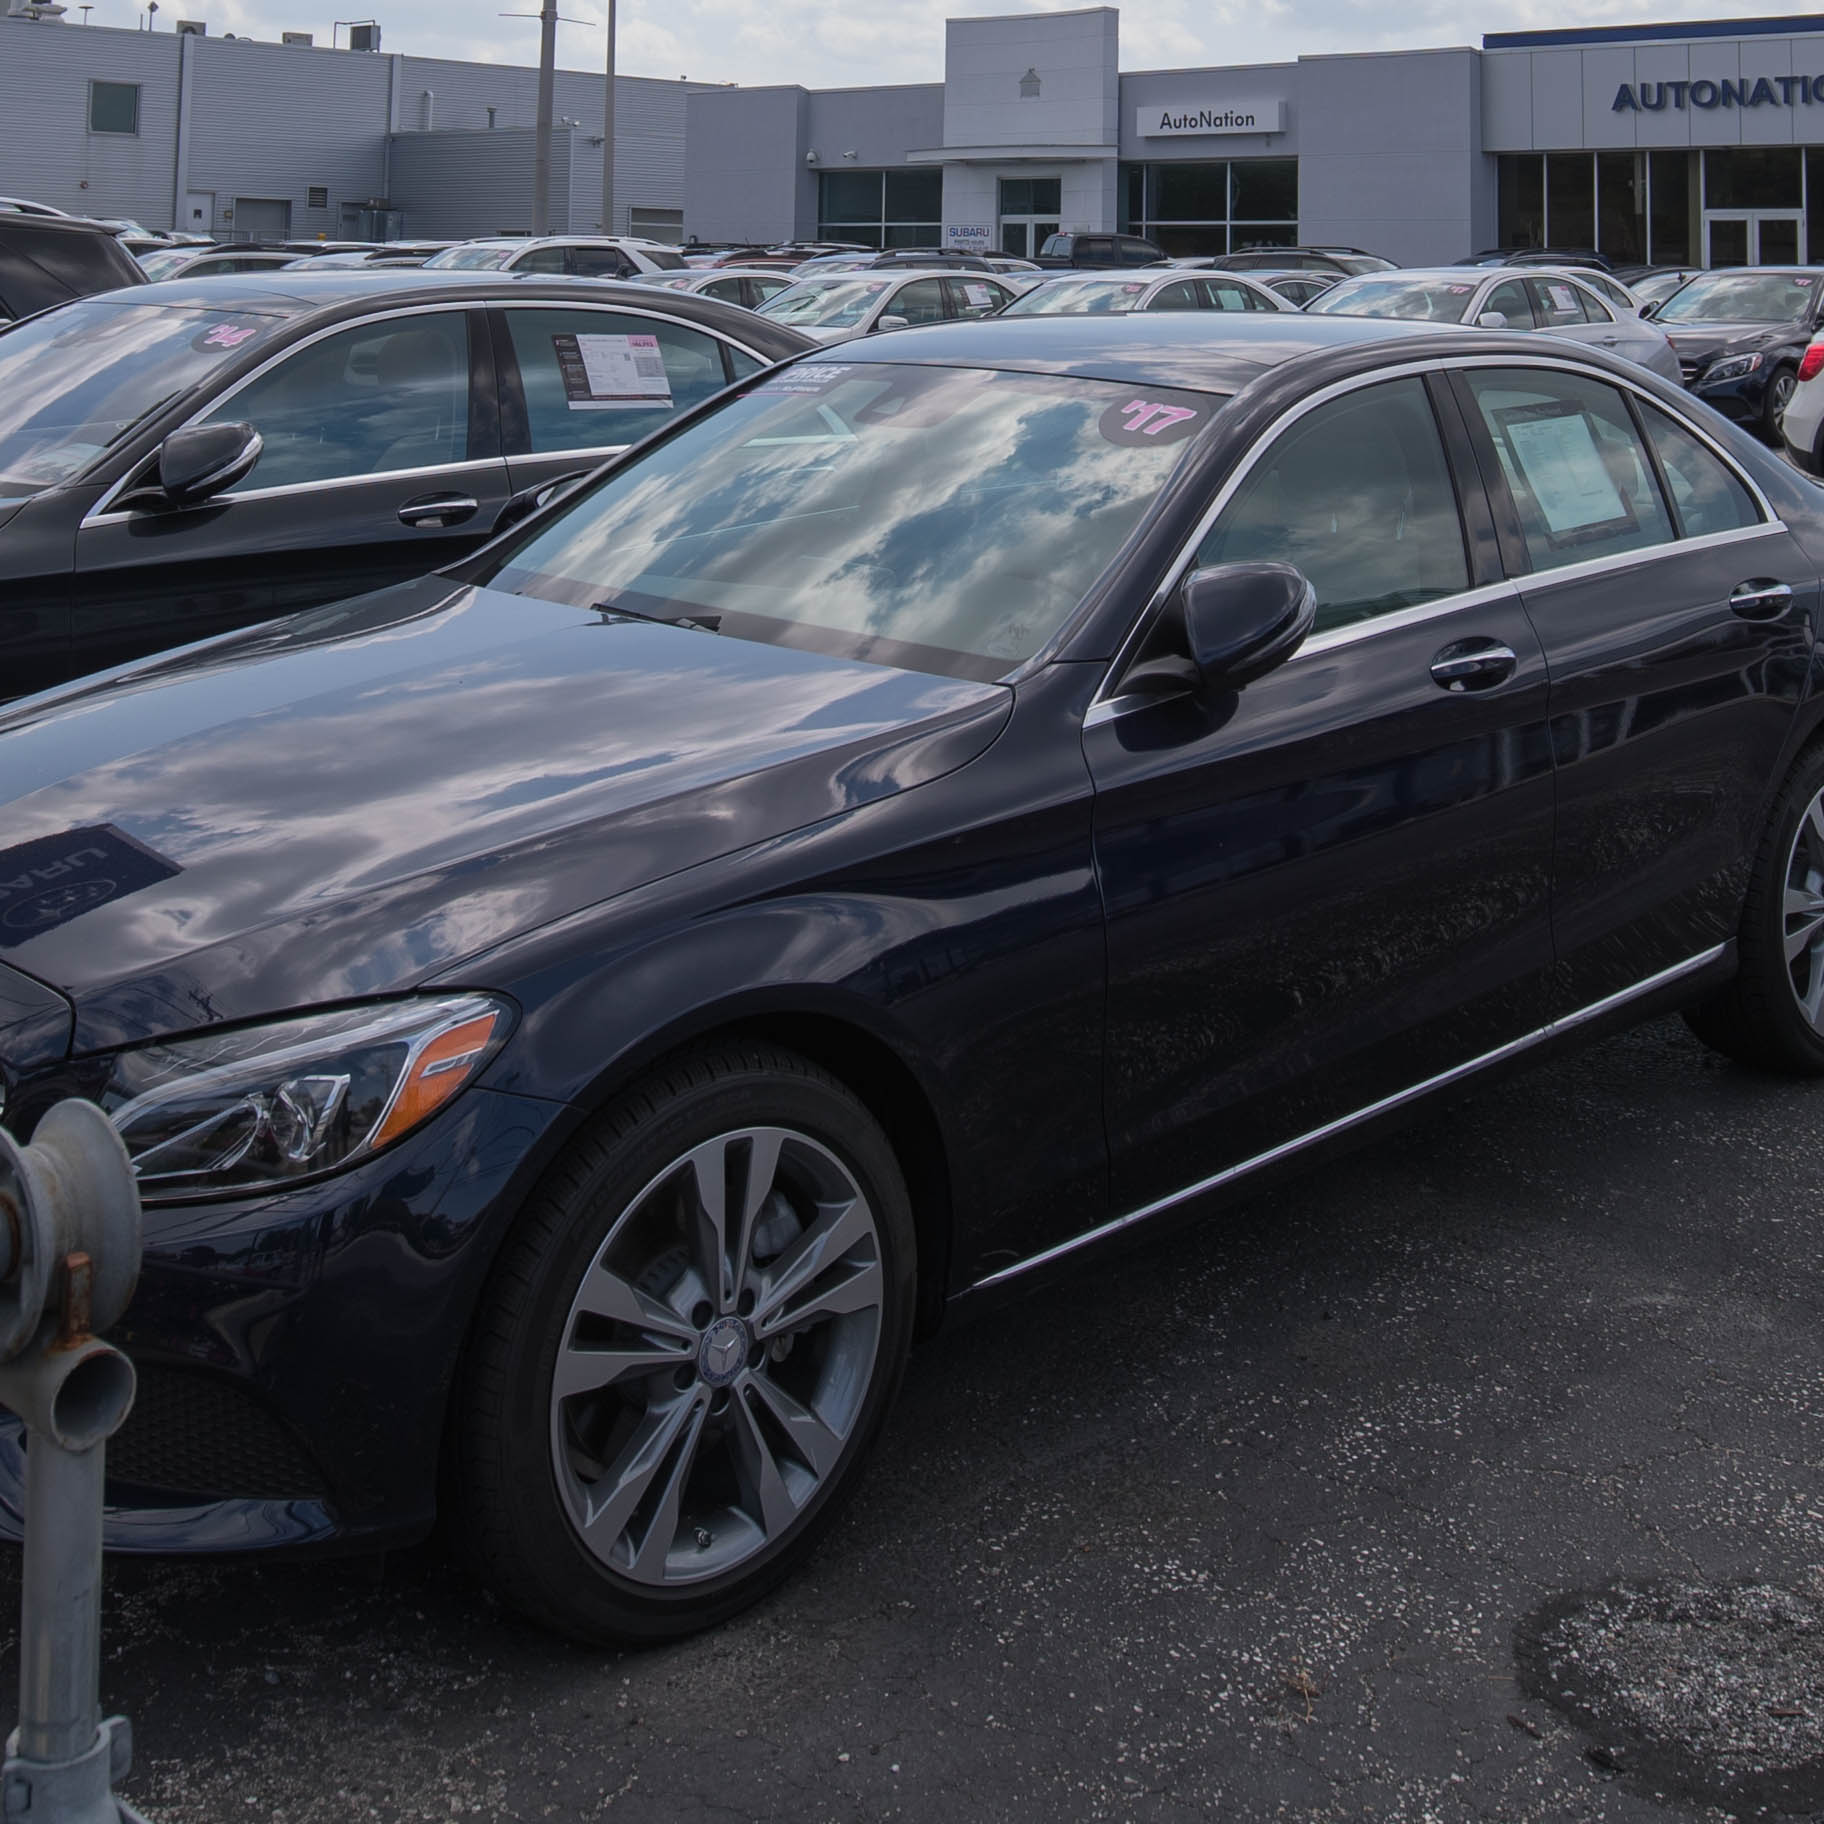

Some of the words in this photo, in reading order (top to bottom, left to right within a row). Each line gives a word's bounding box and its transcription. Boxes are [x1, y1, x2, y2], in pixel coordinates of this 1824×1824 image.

[1159, 110, 1256, 130] AutoNation
[948, 227, 991, 237] SUBARU
[1120, 399, 1198, 436] '17
